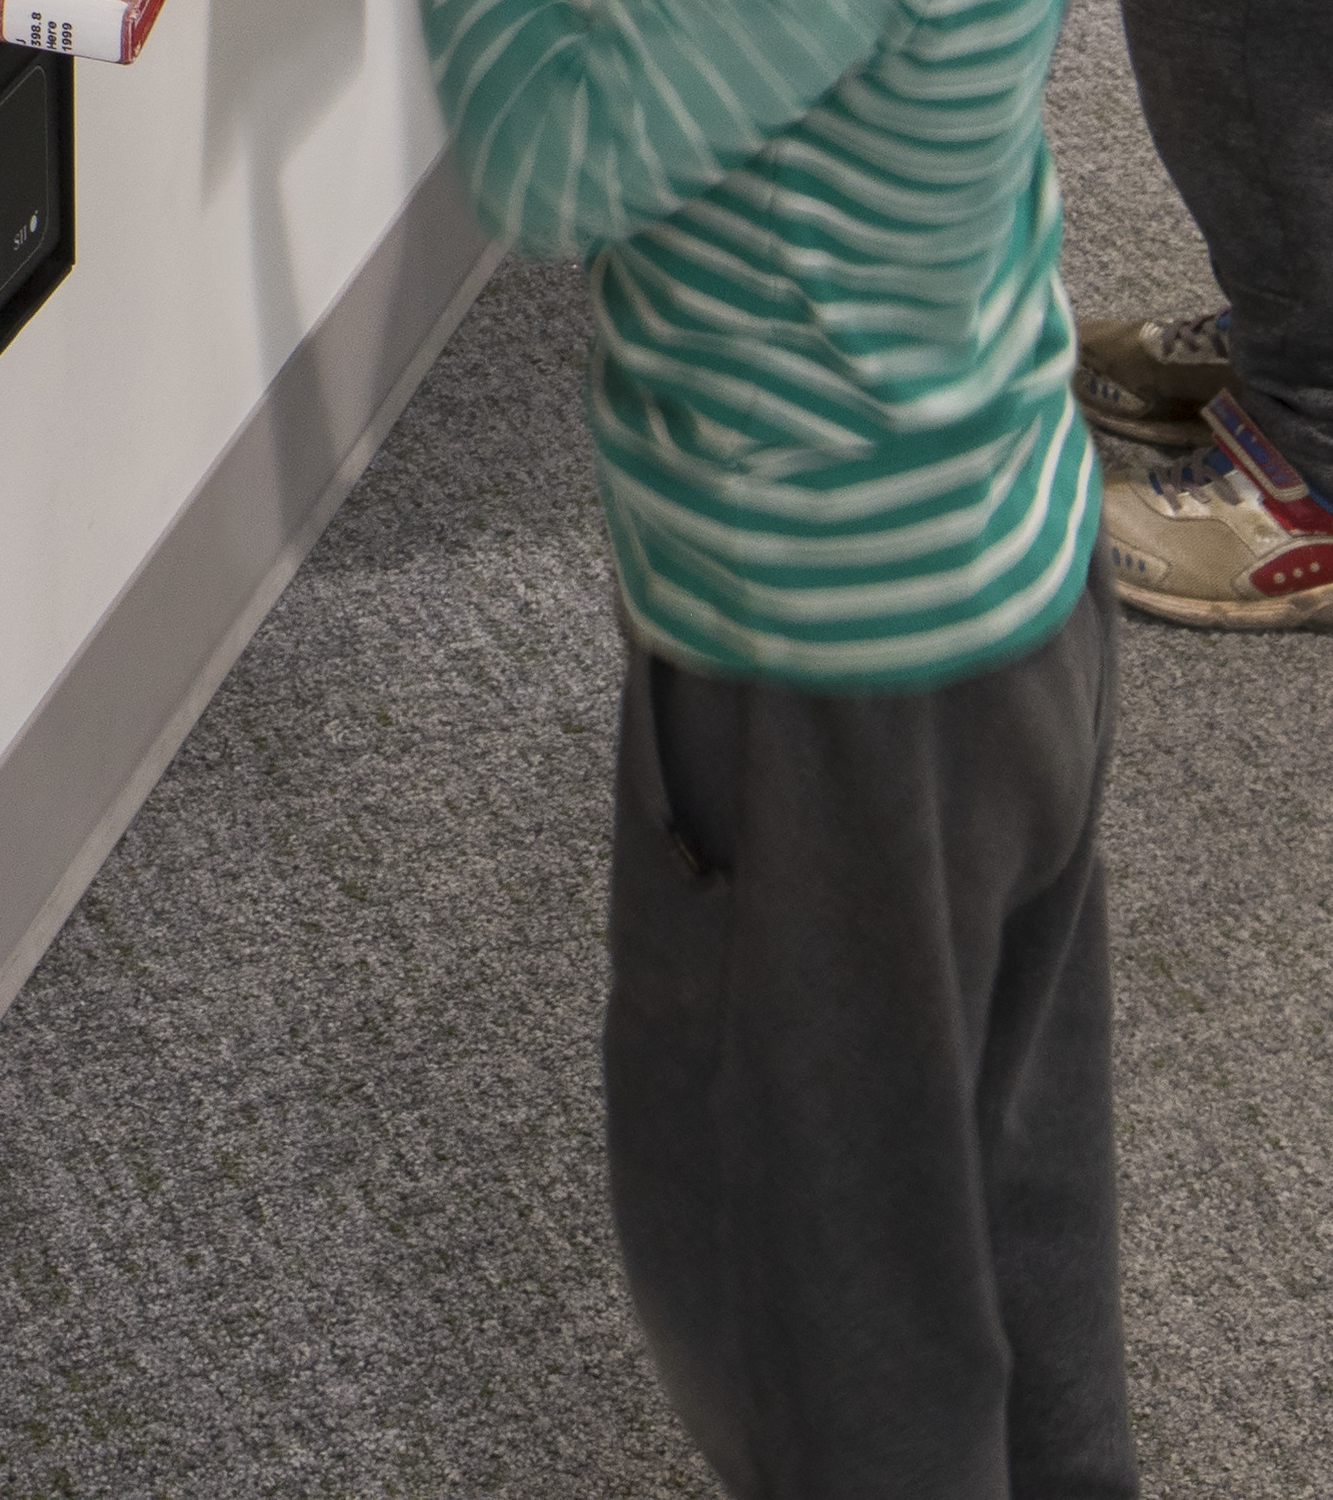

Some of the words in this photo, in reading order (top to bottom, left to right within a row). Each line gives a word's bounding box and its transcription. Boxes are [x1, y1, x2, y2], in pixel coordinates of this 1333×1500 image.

[30, 11, 42, 47] 398.8
[46, 21, 57, 50] Here
[61, 22, 73, 52] 1999
